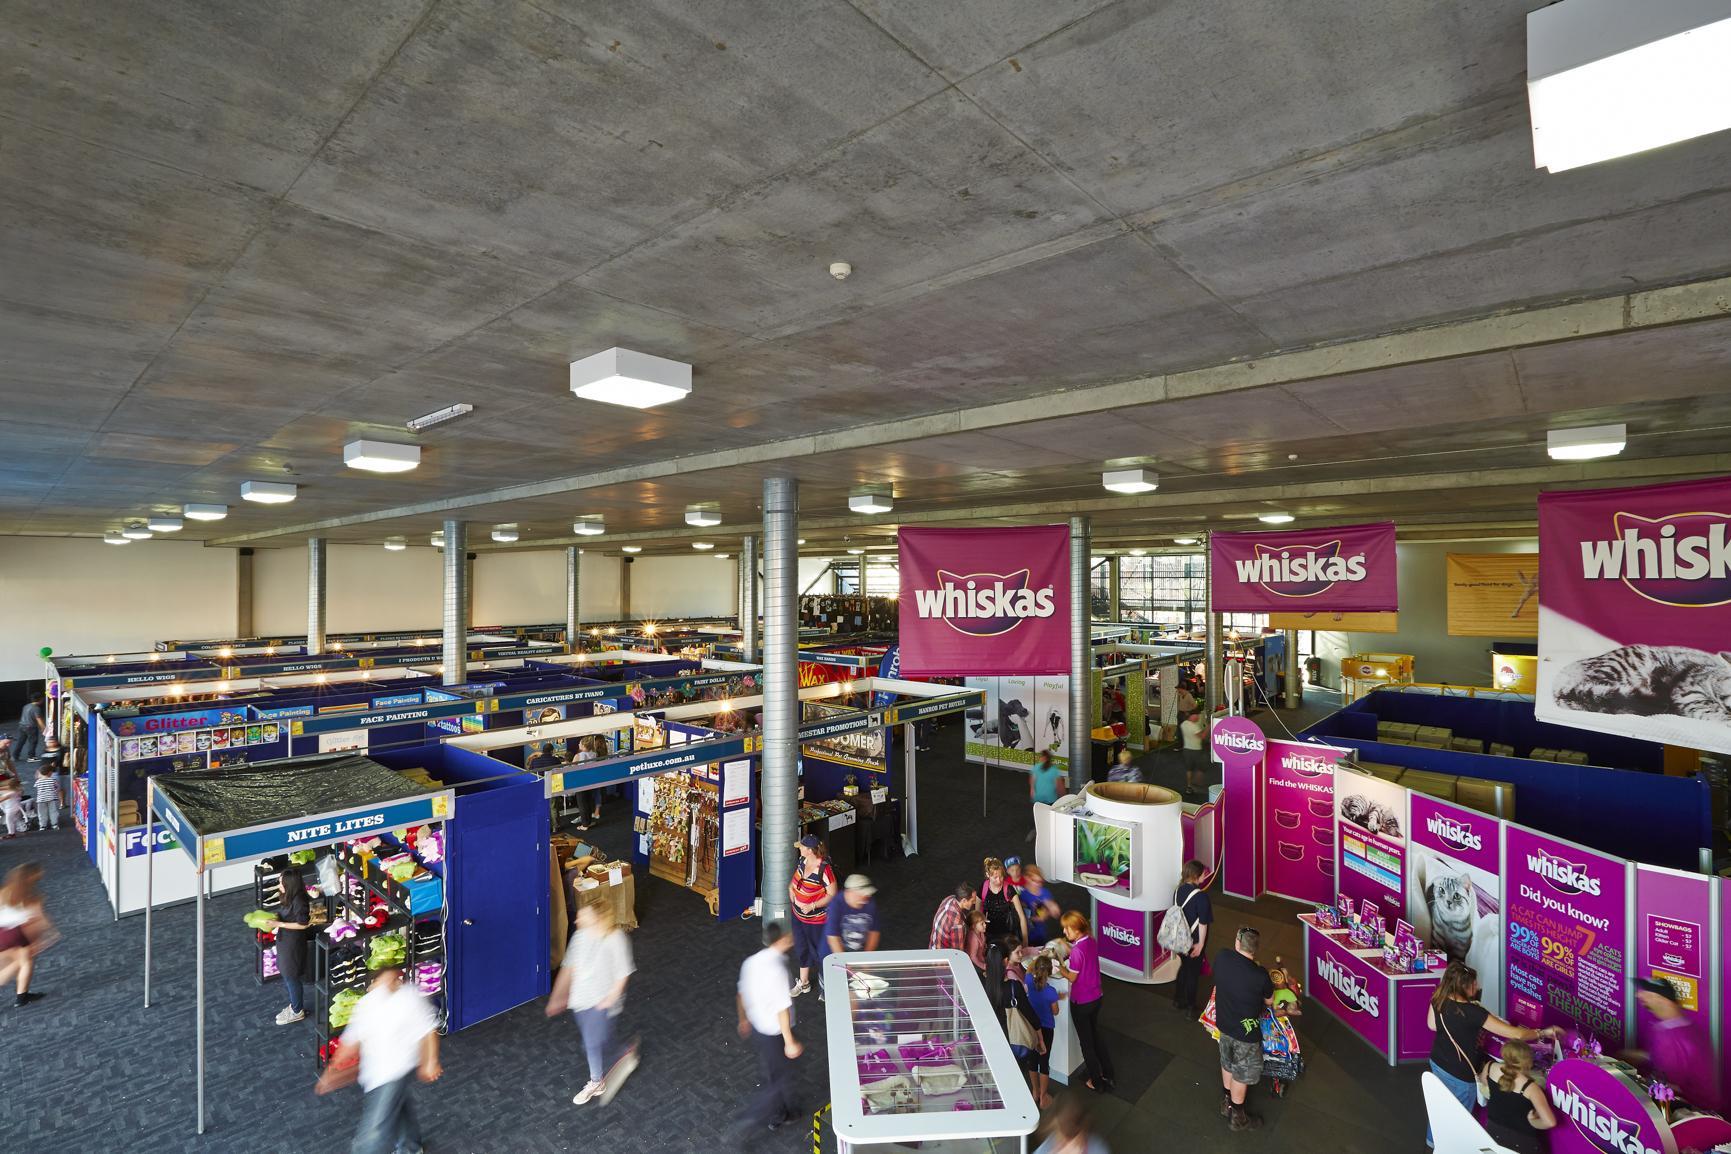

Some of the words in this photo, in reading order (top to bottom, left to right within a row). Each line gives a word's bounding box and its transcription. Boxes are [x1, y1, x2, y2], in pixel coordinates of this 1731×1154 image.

[1235, 550, 1367, 584] whiskas
[915, 580, 1055, 619] whiskas
[1043, 681, 1064, 689] Playful
[393, 696, 420, 705] Painting
[526, 694, 574, 705] CARICATURES
[585, 690, 604, 698] IVANO
[145, 716, 208, 731] Glitter
[279, 709, 311, 718] Painting
[360, 715, 384, 725] FACE
[386, 711, 428, 722] PAINTING
[826, 719, 867, 733] PROMOTIONS
[1214, 732, 1265, 752] whiskas
[629, 754, 695, 775] petluxe.com.au
[1281, 755, 1334, 775] whiskas
[1268, 777, 1284, 788] Find
[1285, 779, 1297, 789] the
[1297, 782, 1334, 794] WHISKAS
[287, 824, 331, 843] NITE
[335, 814, 384, 833] LITES
[1426, 816, 1482, 850] whiskas
[1526, 854, 1601, 896] whiskas
[1520, 884, 1541, 903] Did
[1542, 896, 1566, 914] you
[1567, 903, 1610, 931] know?
[1102, 922, 1141, 947] whiskas
[1510, 921, 1539, 943] 99%
[1654, 920, 1692, 933] SHOWBAGS
[1541, 936, 1574, 960] 99%
[1576, 924, 1596, 956] 7
[1510, 969, 1527, 984] have
[1527, 980, 1537, 990] no
[1511, 963, 1528, 978] Most
[1529, 974, 1543, 986] cats
[1316, 954, 1380, 1018] whiskas
[1510, 979, 1542, 1001] eyelashes
[1547, 983, 1571, 1002] CATS
[1572, 995, 1602, 1018] WALK
[1603, 1012, 1621, 1028] ON
[1547, 991, 1583, 1020] THEIR
[1550, 1083, 1661, 1154] whiska
